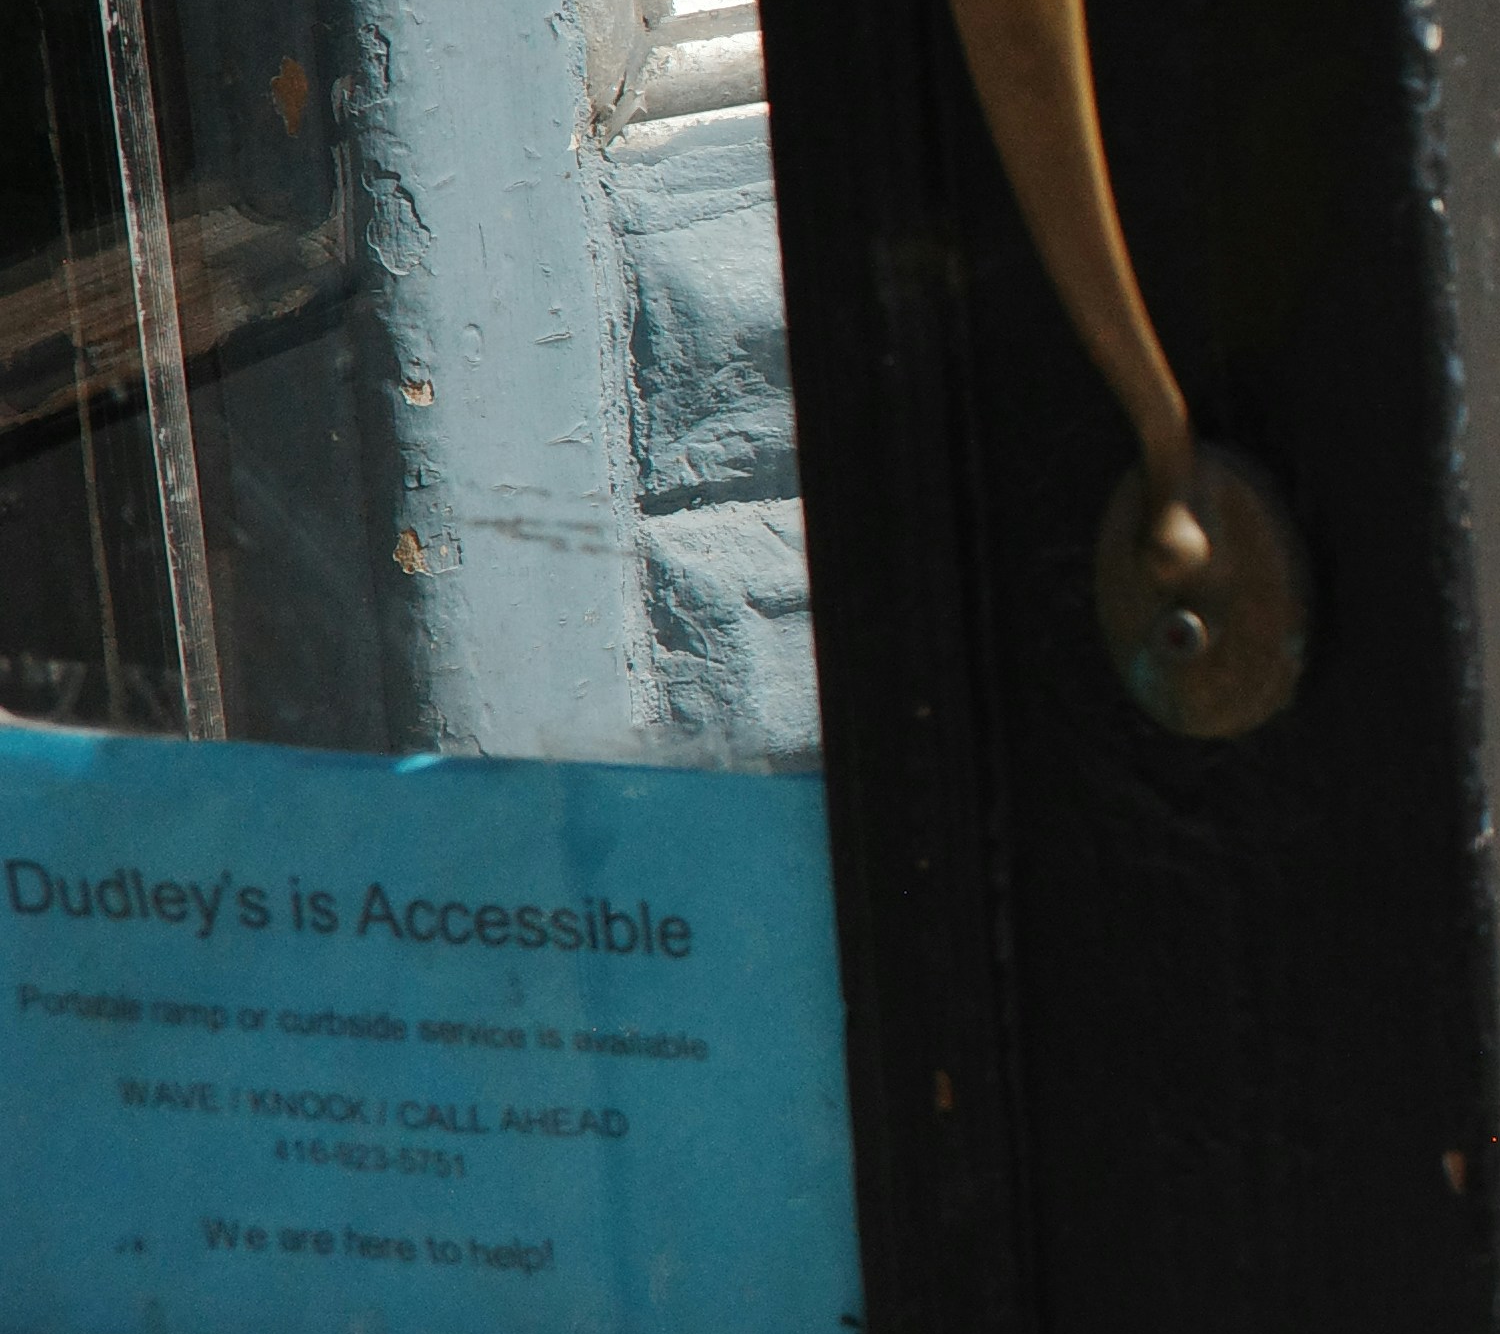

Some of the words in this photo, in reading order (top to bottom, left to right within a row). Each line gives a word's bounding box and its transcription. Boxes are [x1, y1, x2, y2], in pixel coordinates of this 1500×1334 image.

[4, 858, 272, 940] Dudley's
[288, 876, 341, 936] is
[355, 881, 693, 960] Accessible
[117, 1078, 219, 1115] WAVE
[396, 1100, 490, 1136] CALL
[500, 1104, 631, 1140] AHEAD
[200, 1215, 268, 1252] We
[278, 1224, 335, 1256] are
[425, 1233, 463, 1267] to
